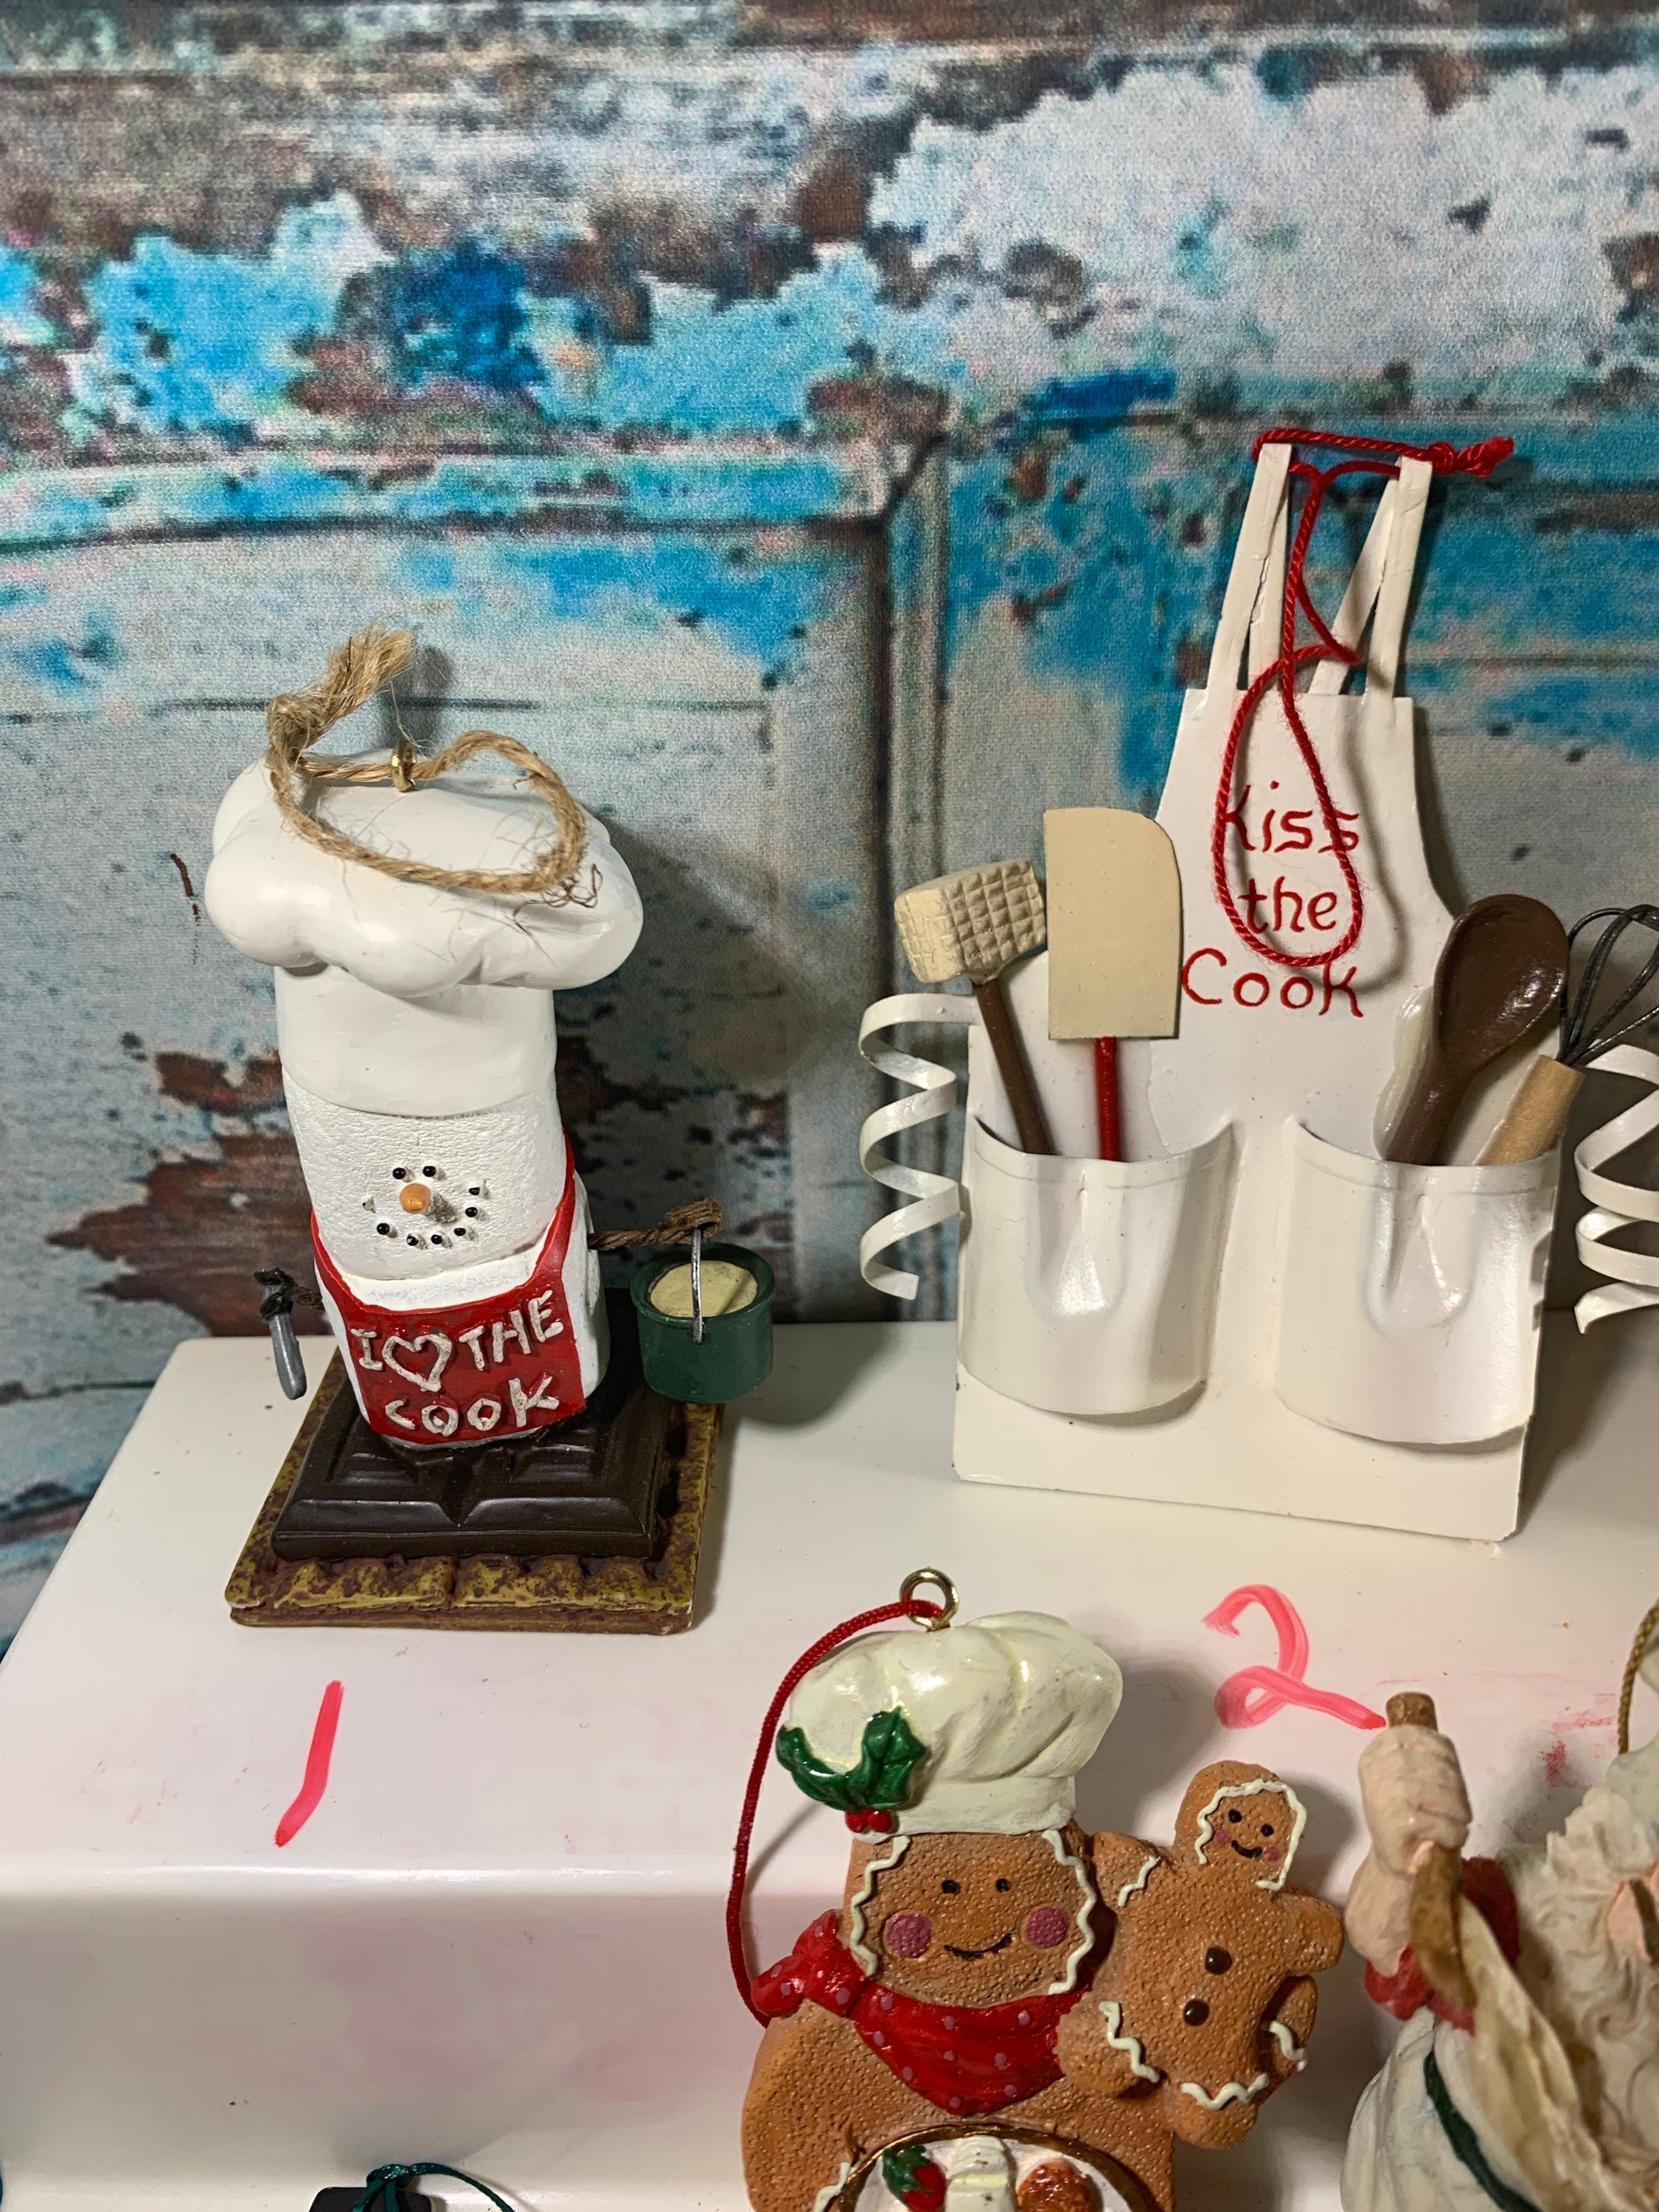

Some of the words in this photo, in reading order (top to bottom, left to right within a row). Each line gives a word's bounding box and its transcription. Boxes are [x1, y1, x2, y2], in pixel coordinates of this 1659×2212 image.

[1237, 875, 1337, 934] the
[350, 1328, 383, 1371] I
[459, 1289, 564, 1371] THE
[384, 1372, 560, 1437] COOK
[1200, 1583, 1388, 1730] 2
[274, 1679, 345, 1848] 1
